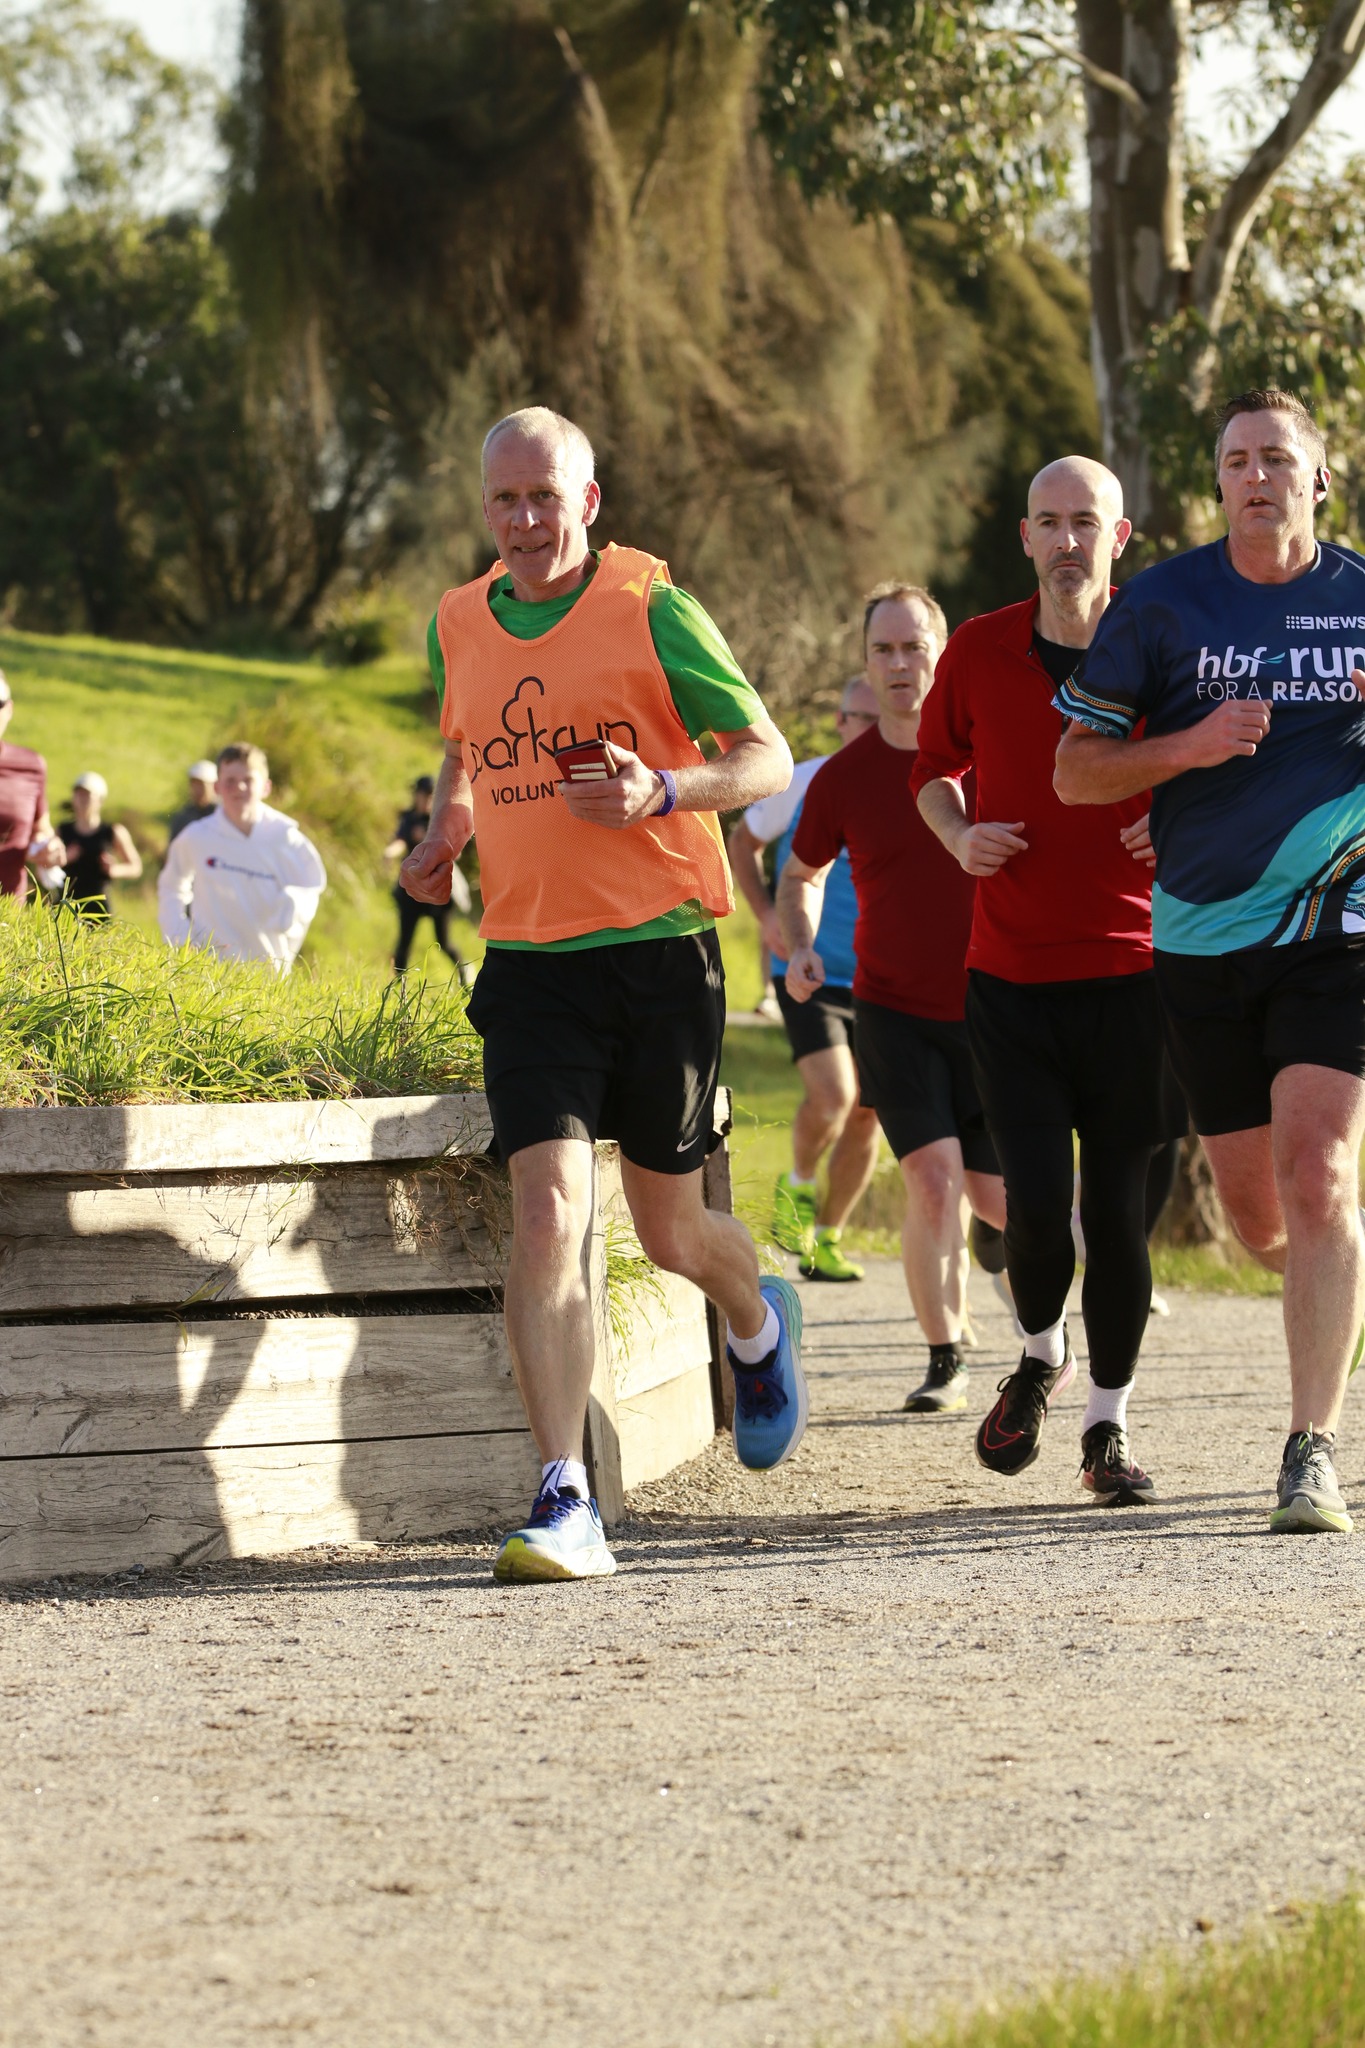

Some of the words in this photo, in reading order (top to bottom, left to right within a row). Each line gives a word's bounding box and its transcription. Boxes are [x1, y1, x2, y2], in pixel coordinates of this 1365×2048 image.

[1197, 646, 1267, 679] hbf
[1196, 681, 1238, 701] FOR
[1246, 681, 1261, 701] A
[1272, 681, 1363, 703] REASO
